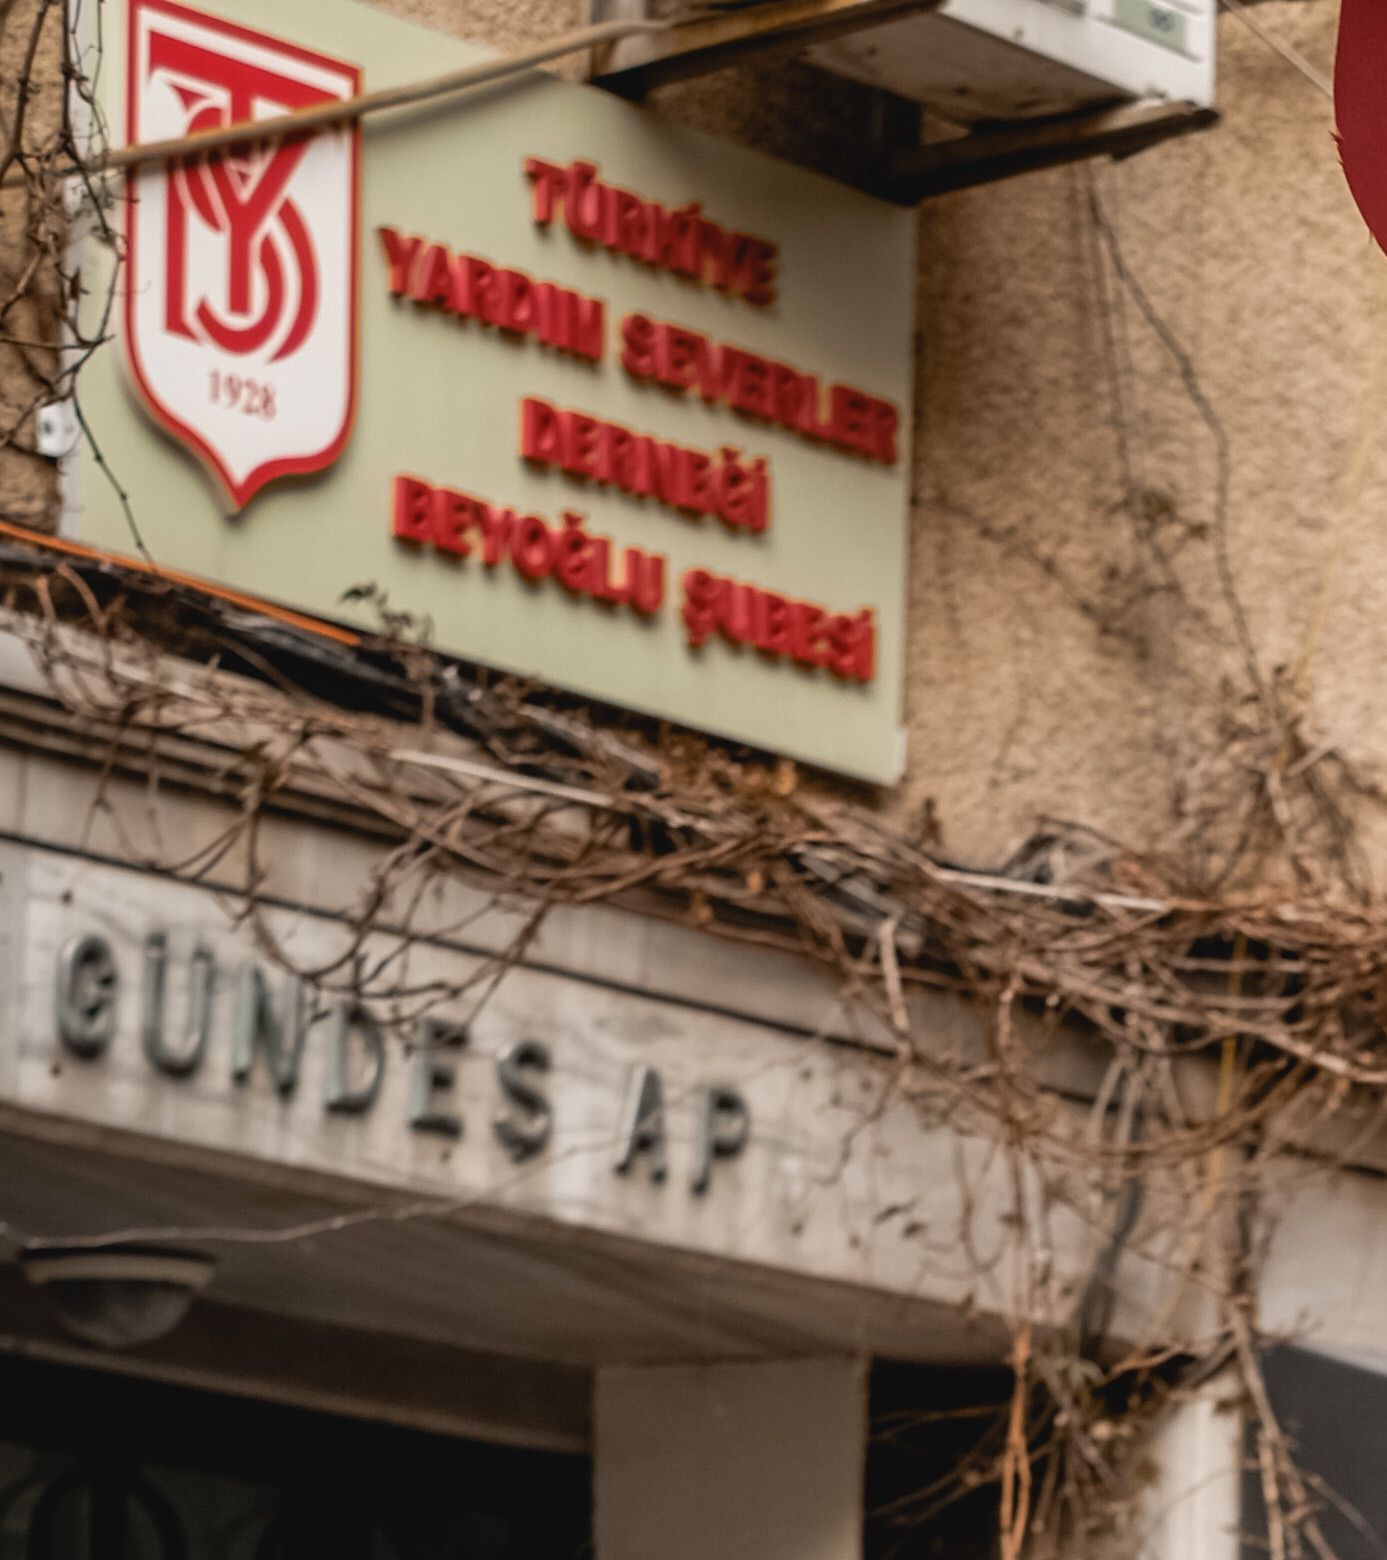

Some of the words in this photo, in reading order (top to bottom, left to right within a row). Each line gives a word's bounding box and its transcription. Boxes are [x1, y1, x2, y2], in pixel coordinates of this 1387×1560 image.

[376, 224, 606, 365] YARDIM
[521, 156, 780, 312] TÜRKİYE
[208, 367, 278, 422] 1928
[520, 396, 770, 536] DERNEĞİ
[392, 473, 666, 617] BEYOĞLU
[681, 567, 876, 684] ŞUBESİ
[614, 1062, 750, 1197] AP
